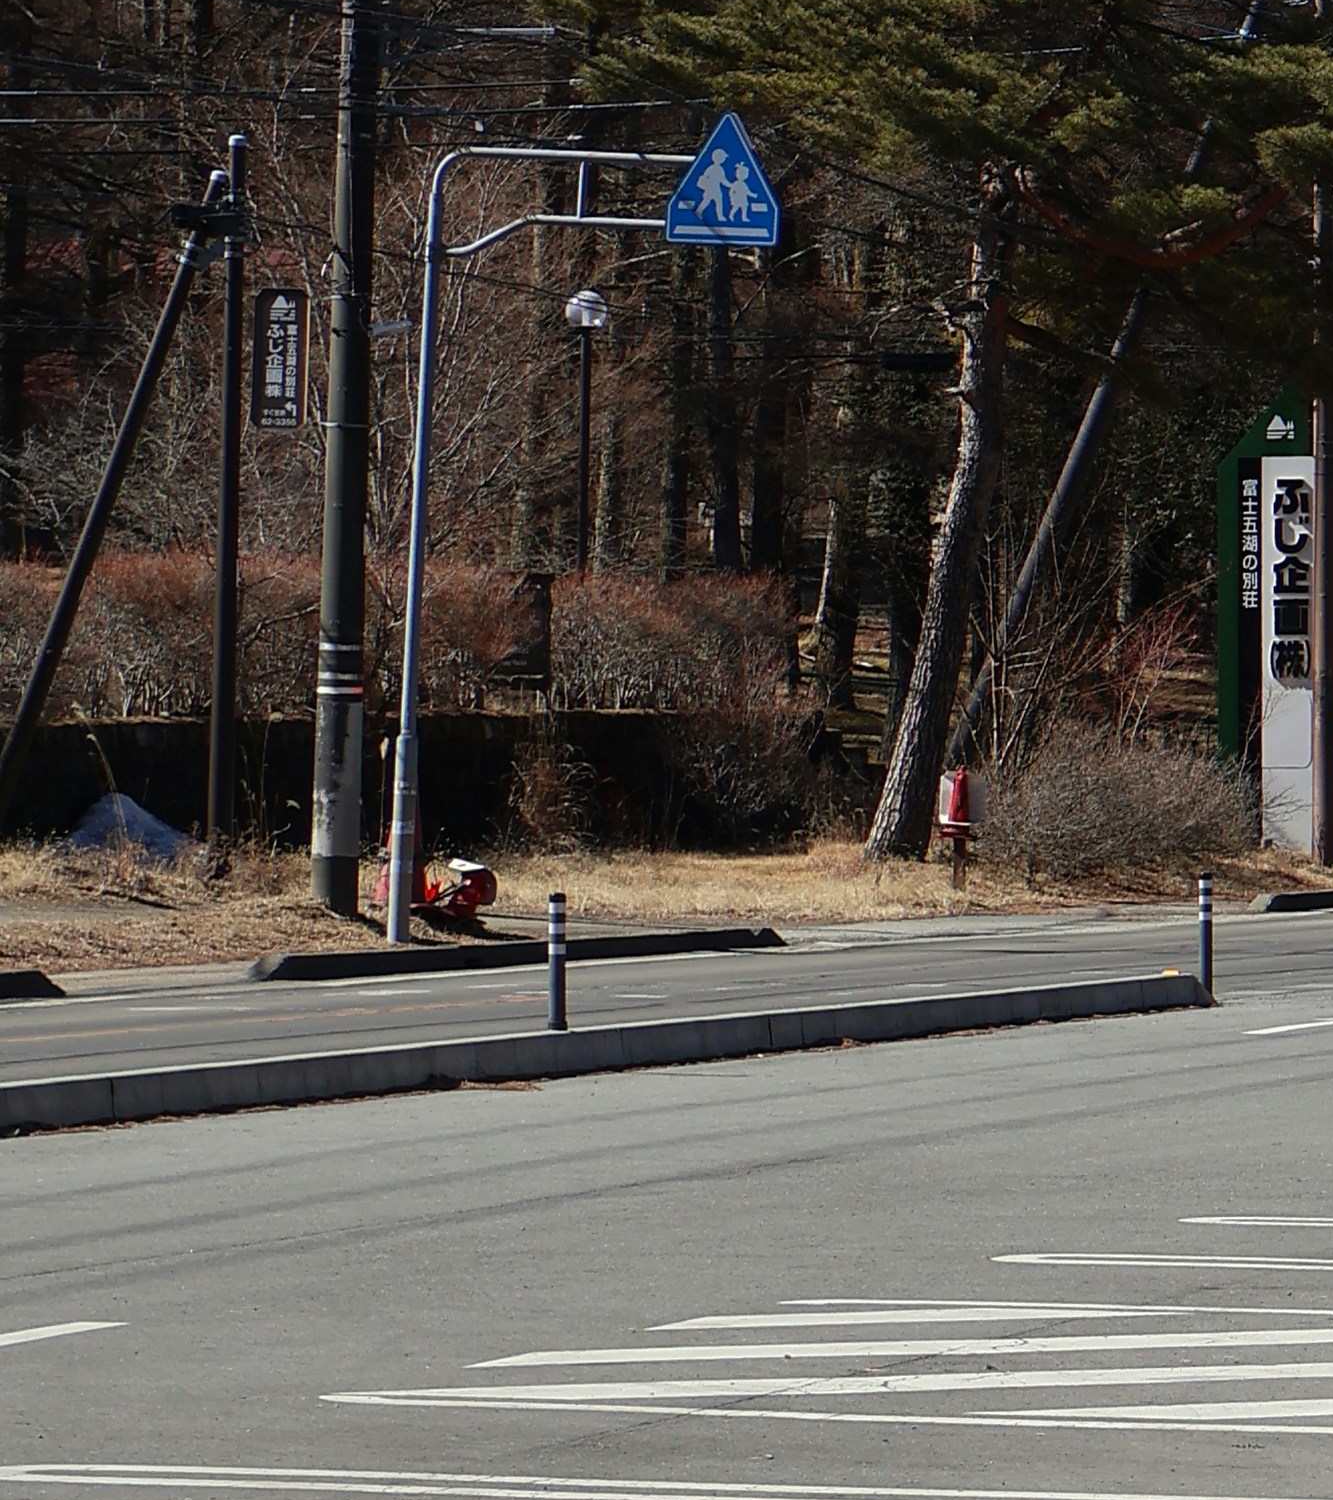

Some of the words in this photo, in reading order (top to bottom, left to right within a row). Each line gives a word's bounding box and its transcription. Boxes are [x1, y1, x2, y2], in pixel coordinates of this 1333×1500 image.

[1242, 479, 1259, 609] 富士五湖の別荘
